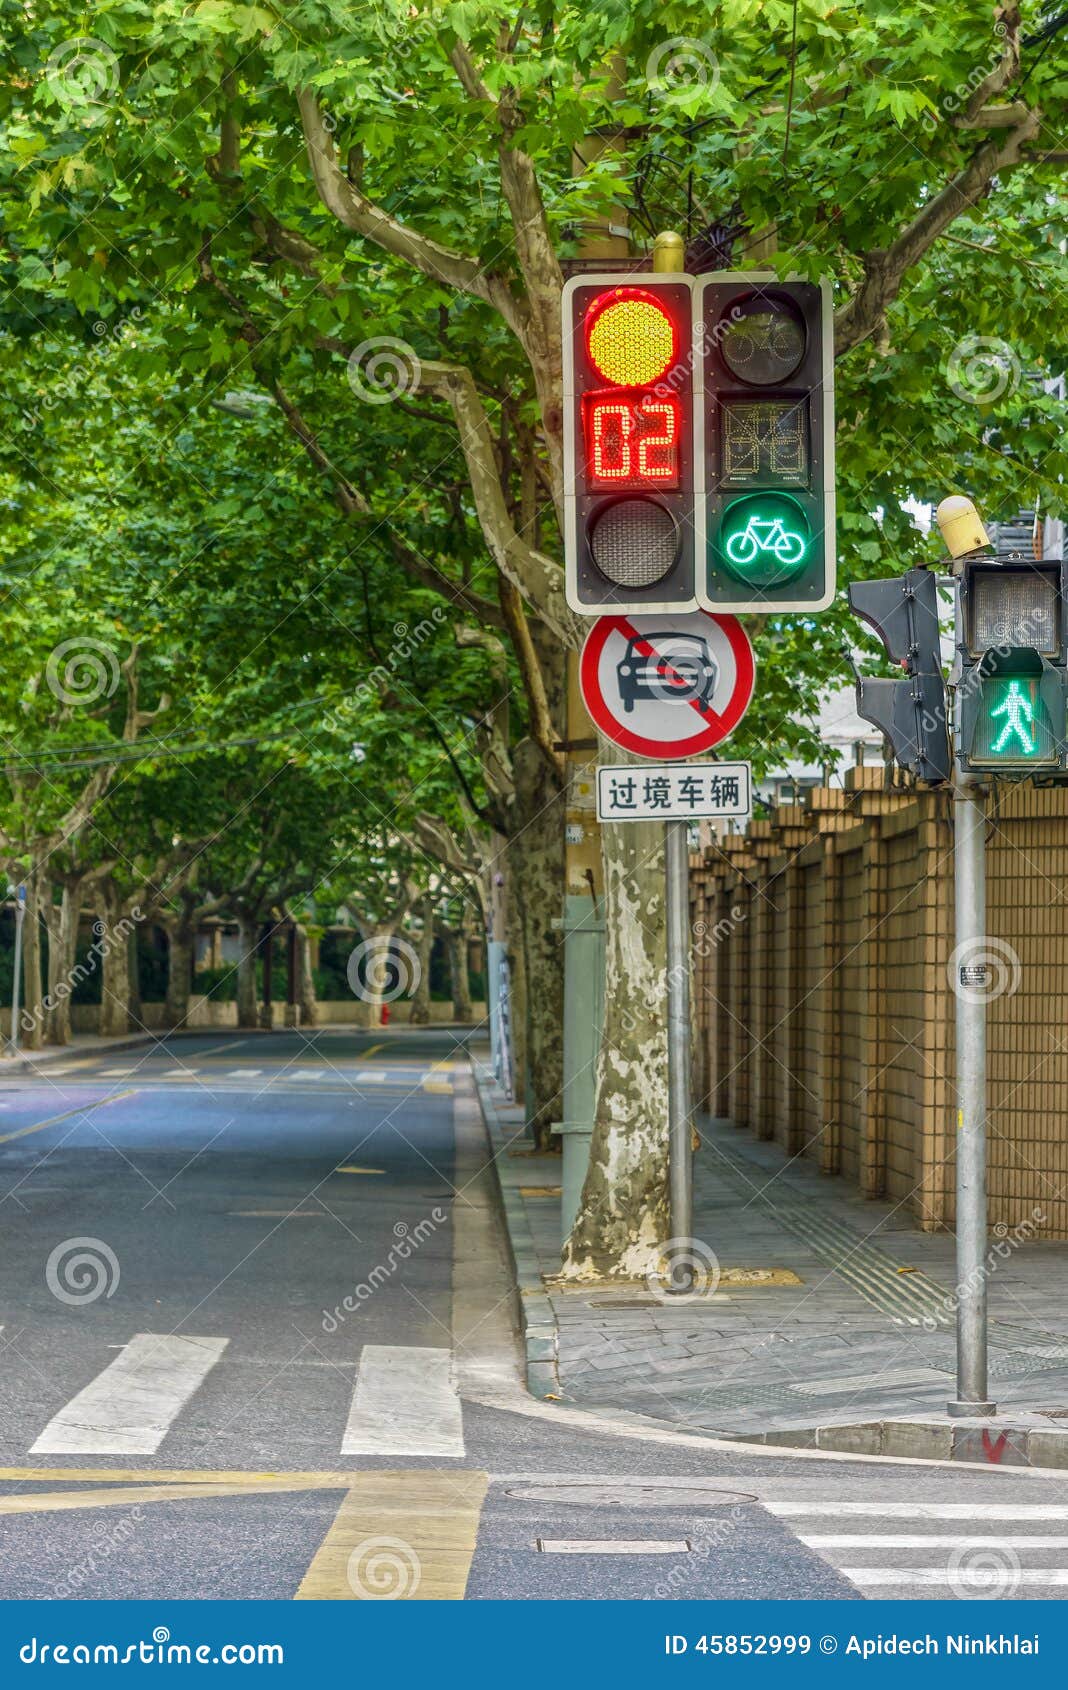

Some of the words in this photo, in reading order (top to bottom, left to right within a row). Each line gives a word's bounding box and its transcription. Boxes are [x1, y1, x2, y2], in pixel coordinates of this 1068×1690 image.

[593, 404, 675, 478] 02
[609, 774, 740, 810] 过境车辆
